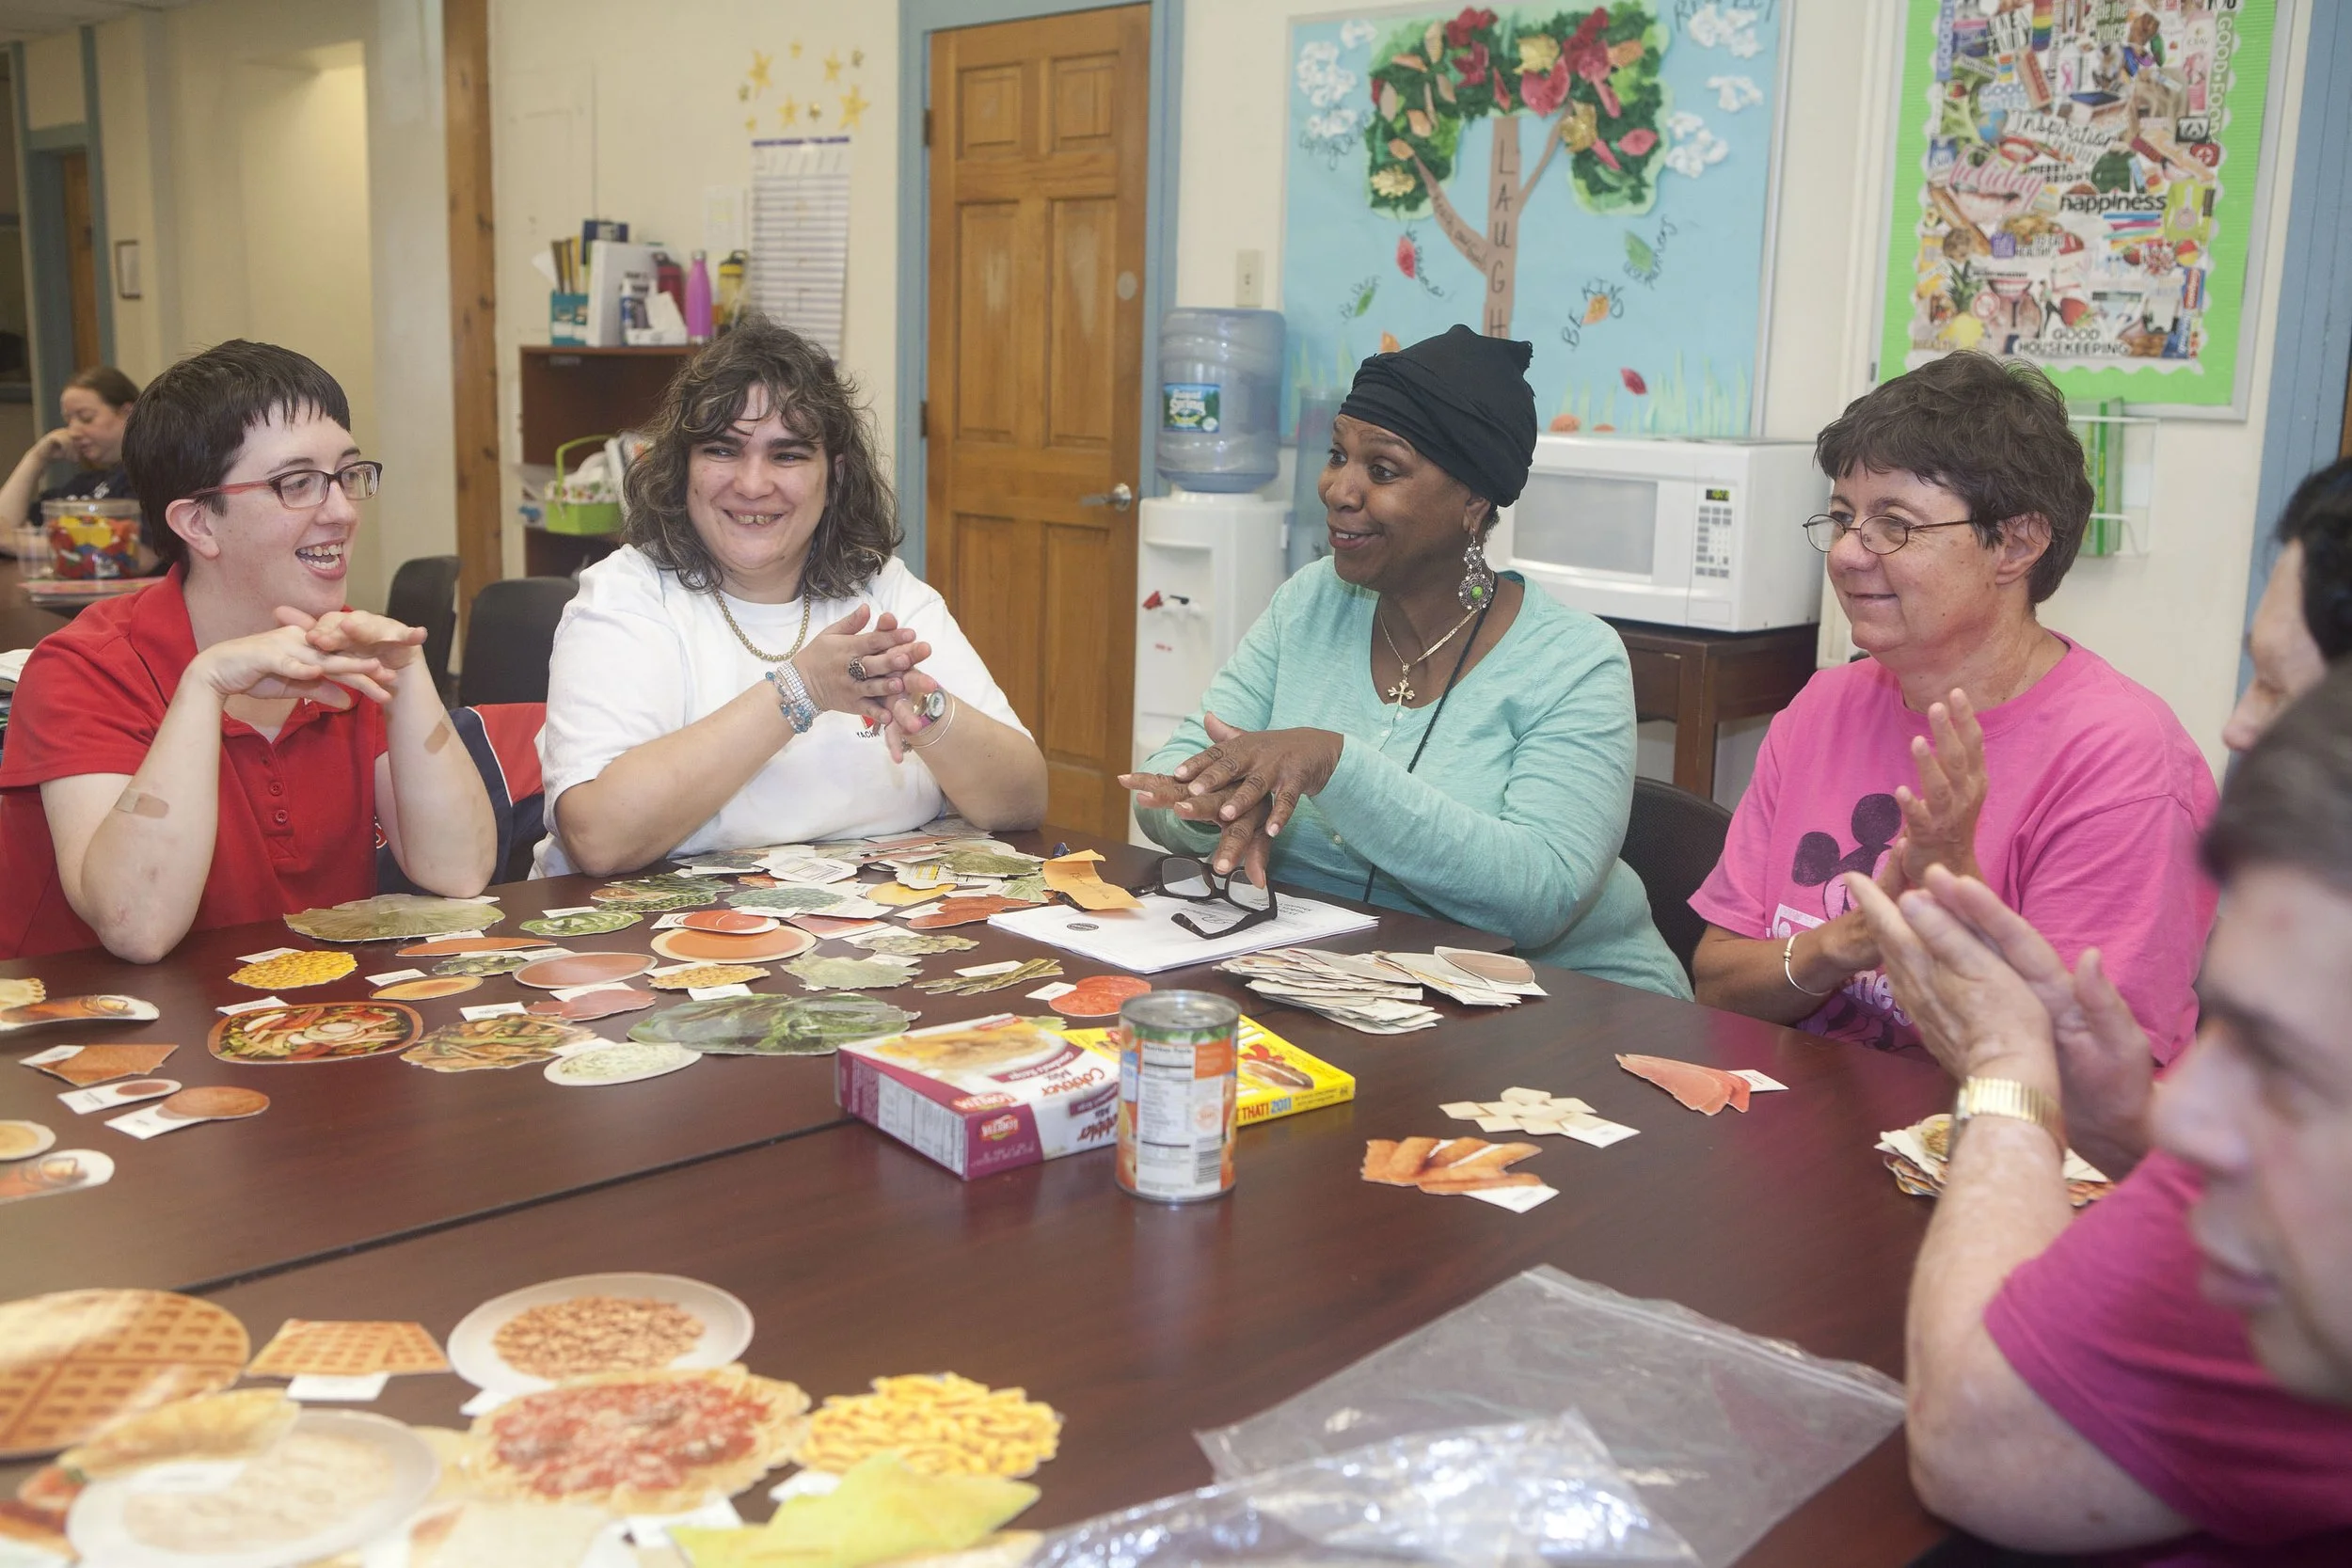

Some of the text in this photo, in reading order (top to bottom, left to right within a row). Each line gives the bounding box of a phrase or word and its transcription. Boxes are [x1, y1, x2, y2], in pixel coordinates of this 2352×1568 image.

[2214, 16, 2233, 73] GOOD
[2059, 191, 2168, 214] happiness
[1488, 137, 1517, 339] LAUGH
[2053, 327, 2100, 341] GOOD
[2018, 341, 2131, 356] HOUSEKEEPING
[1041, 1067, 1105, 1098] Cobbler
[1242, 1101, 1270, 1120] THAT!
